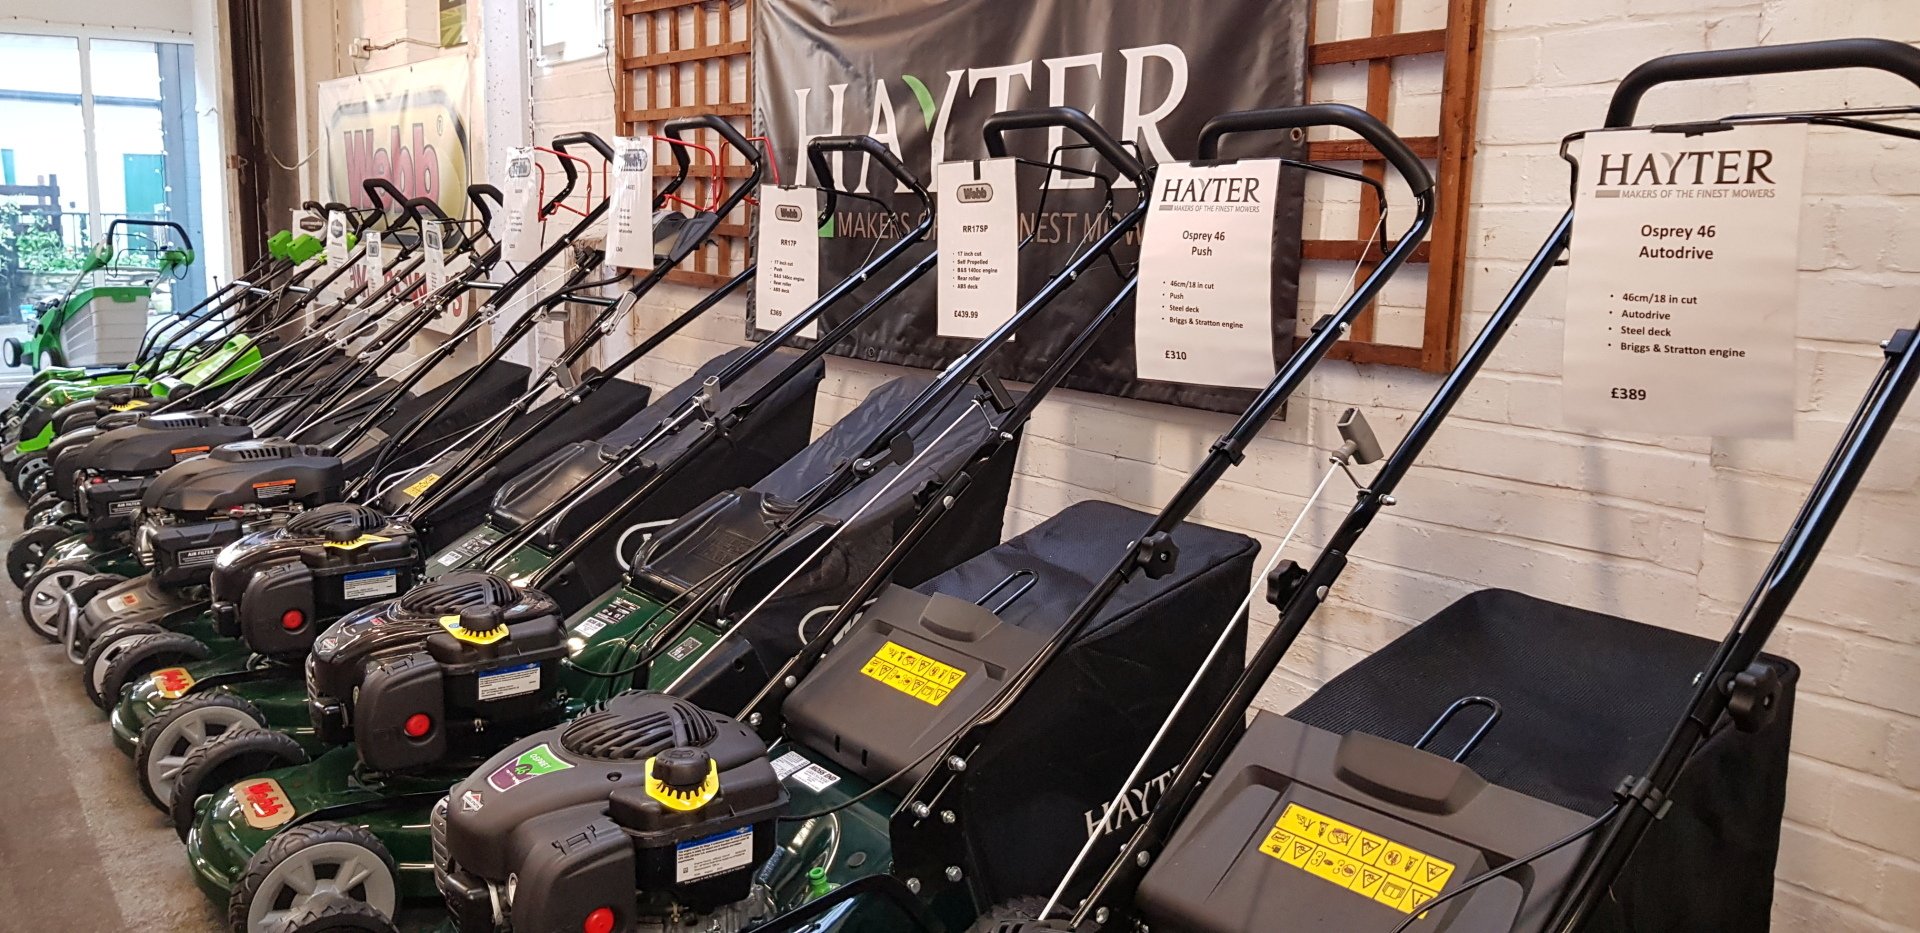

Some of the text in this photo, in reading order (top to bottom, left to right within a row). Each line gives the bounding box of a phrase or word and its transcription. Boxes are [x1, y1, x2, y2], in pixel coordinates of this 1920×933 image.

[793, 43, 1189, 195] HAYTER
[344, 122, 440, 214] Webb
[1596, 149, 1777, 186] HAYTER
[963, 187, 988, 200] Webb
[1160, 177, 1261, 204] HAYTER
[1621, 188, 1776, 199] MAKERS OF THE FINEST MOWERS
[1174, 204, 1194, 212] MAKERS
[1235, 205, 1260, 213] MOWERS
[838, 212, 910, 240] MAKERS
[1019, 212, 1077, 244] NEST
[962, 224, 988, 233] RR17SP
[1641, 224, 1716, 240] Osprey 46
[1182, 230, 1226, 243] Osprey 46
[780, 239, 797, 247] RR17P
[1192, 246, 1212, 256] Push
[1639, 245, 1714, 260] Autodrive
[966, 258, 988, 266] Propelled
[1170, 280, 1196, 289] 46cm/18
[1170, 292, 1184, 300] Push
[1622, 292, 1698, 305] 46cm/18 in cut
[954, 310, 979, 319] £439.99
[1169, 304, 1200, 313] Steel deck
[1622, 309, 1671, 321] Autodrive
[1169, 316, 1188, 326] Briggs
[1195, 318, 1220, 327] Stratton
[1221, 321, 1244, 330] engine
[1621, 325, 1671, 337] Steel deck
[1165, 350, 1187, 360] £310
[1620, 342, 1746, 358] Briggs & Stratton engine
[1611, 387, 1647, 401] £389
